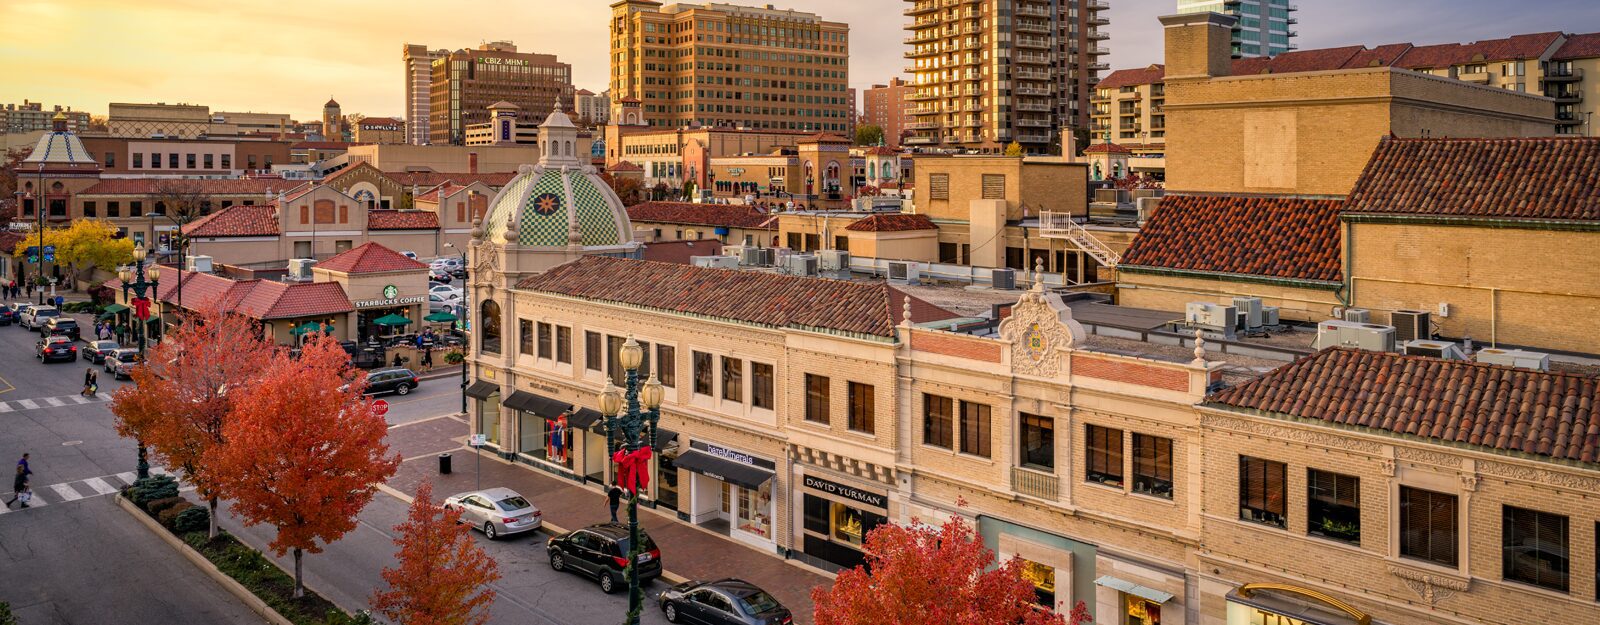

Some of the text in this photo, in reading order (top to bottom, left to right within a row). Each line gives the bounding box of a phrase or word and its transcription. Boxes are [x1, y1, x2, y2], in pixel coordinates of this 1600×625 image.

[484, 57, 523, 66] CBIZ MHM
[355, 296, 425, 308] STARBUCKS COFFEE
[372, 404, 388, 412] STOP
[707, 444, 753, 465] bareMinerals
[806, 478, 881, 505] DAVID YURMAN
